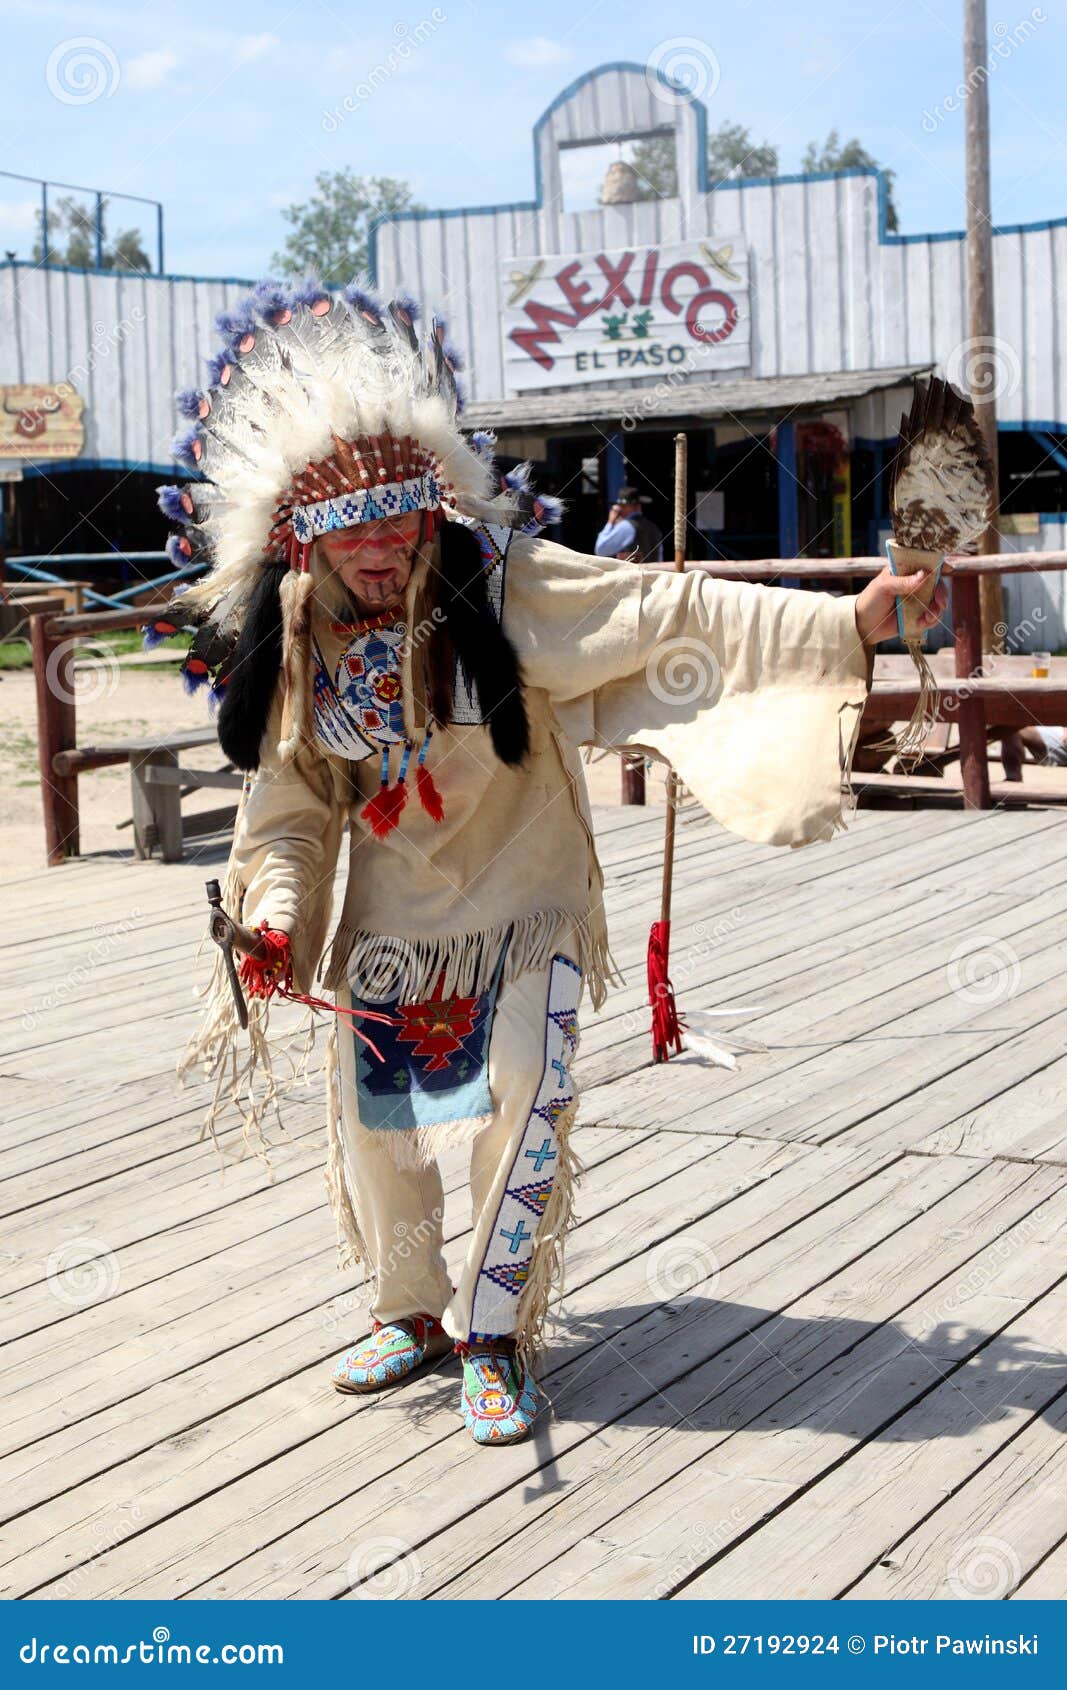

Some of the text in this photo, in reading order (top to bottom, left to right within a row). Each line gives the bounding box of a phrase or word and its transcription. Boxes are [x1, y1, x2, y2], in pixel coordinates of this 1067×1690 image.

[508, 251, 738, 371] MEXICO
[575, 344, 686, 371] EL PASO
